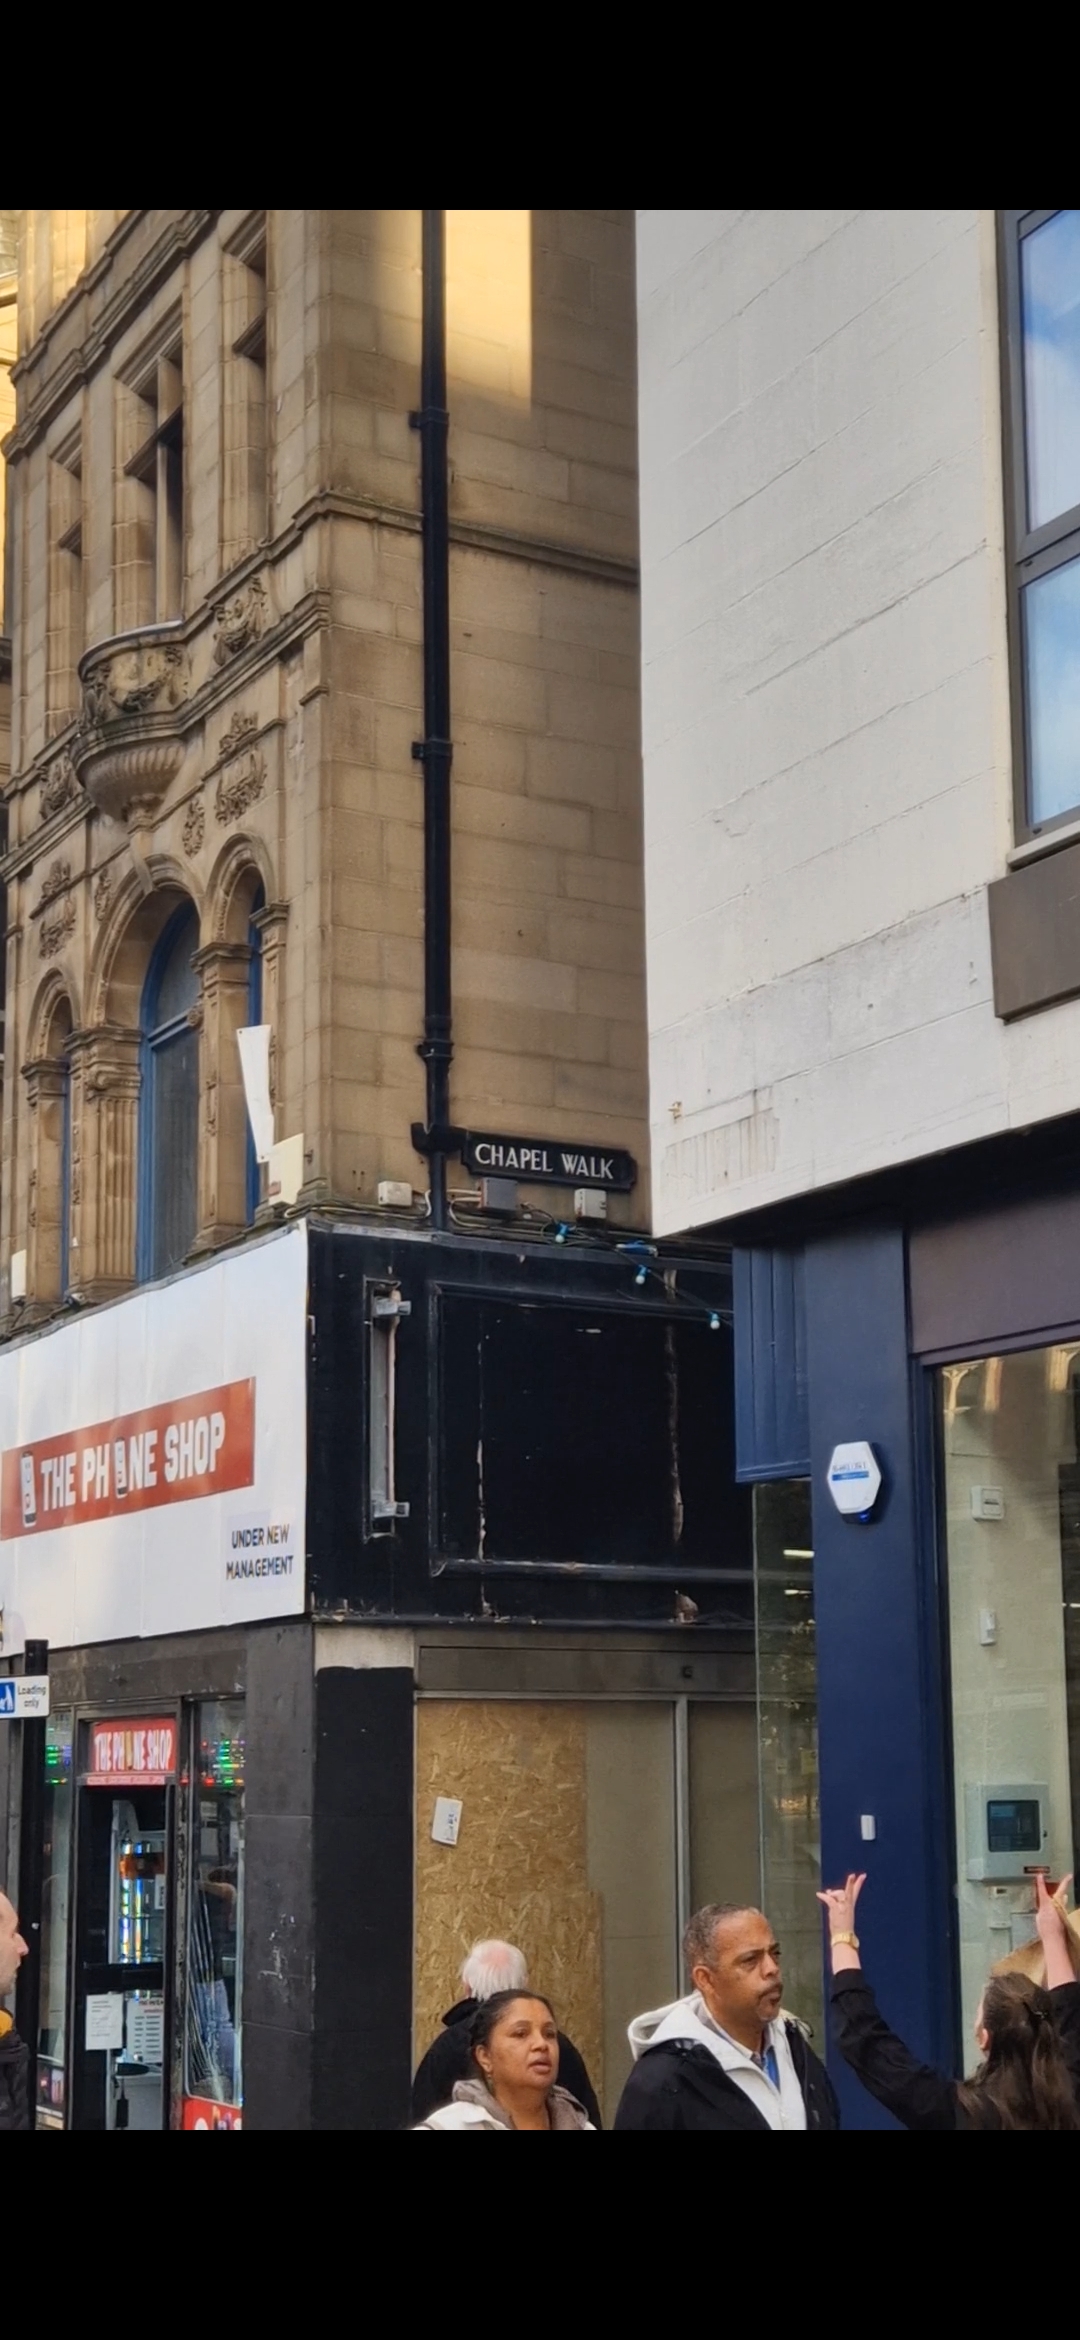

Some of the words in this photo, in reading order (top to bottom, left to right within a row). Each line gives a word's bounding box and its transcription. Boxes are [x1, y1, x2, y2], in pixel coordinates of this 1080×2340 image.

[474, 1142, 553, 1174] CHAPEL
[561, 1152, 615, 1180] WALK
[40, 1452, 77, 1512] THE
[81, 1429, 159, 1503] PHNE
[164, 1411, 226, 1484] SHOP
[231, 1527, 264, 1550] UNDER
[266, 1523, 290, 1546] NEW
[225, 1555, 294, 1581] MANAGEMENT
[17, 1684, 47, 1696] Loading
[24, 1698, 40, 1709] only
[94, 1731, 113, 1772] THE
[112, 1730, 147, 1772] PHNE
[147, 1729, 173, 1771] SHOP
